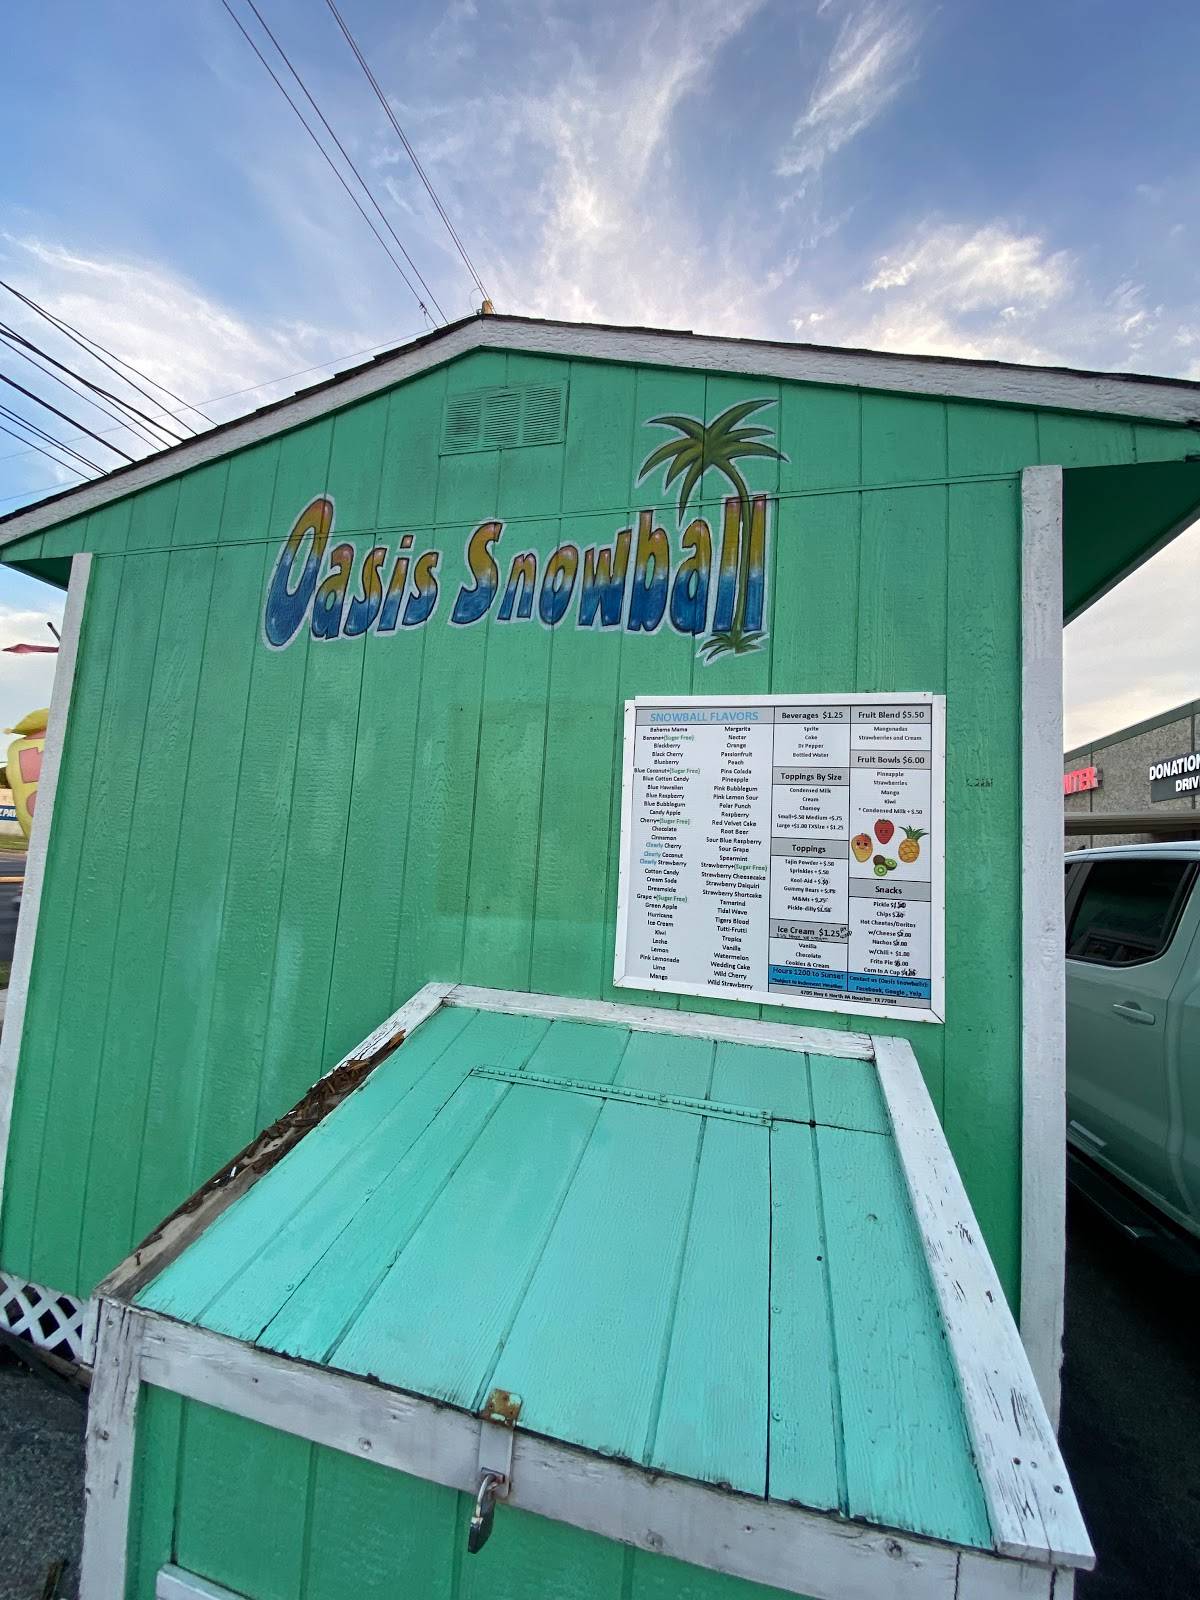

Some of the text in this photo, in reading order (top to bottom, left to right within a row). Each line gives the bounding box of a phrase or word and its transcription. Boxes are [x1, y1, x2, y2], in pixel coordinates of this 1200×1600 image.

[265, 494, 768, 647] Oasis Snowball
[650, 712, 759, 722] SNOWBALL FLAVORS
[822, 711, 843, 719] $1.25
[878, 711, 900, 719] Blend
[902, 711, 925, 719] $5.50
[877, 756, 901, 764] Bowls
[902, 756, 925, 764] $6.00
[780, 772, 842, 782] Toppings By Size
[733, 838, 762, 846] Raspberry
[792, 844, 826, 854] Toppings
[702, 889, 733, 897] Strawberry
[875, 885, 902, 894] Snacks
[777, 925, 789, 933] Ice
[790, 926, 815, 935] Cream
[819, 928, 840, 937] $1.25
[652, 955, 680, 963] Lemonade
[713, 952, 749, 961] Watermelon
[795, 951, 821, 959] Chocolate
[710, 961, 736, 969] Wedding
[649, 973, 668, 981] Mango
[727, 971, 747, 980] Cherry
[773, 967, 793, 975] Hours
[821, 970, 844, 980] Sunset
[721, 980, 754, 990] Strawberry
